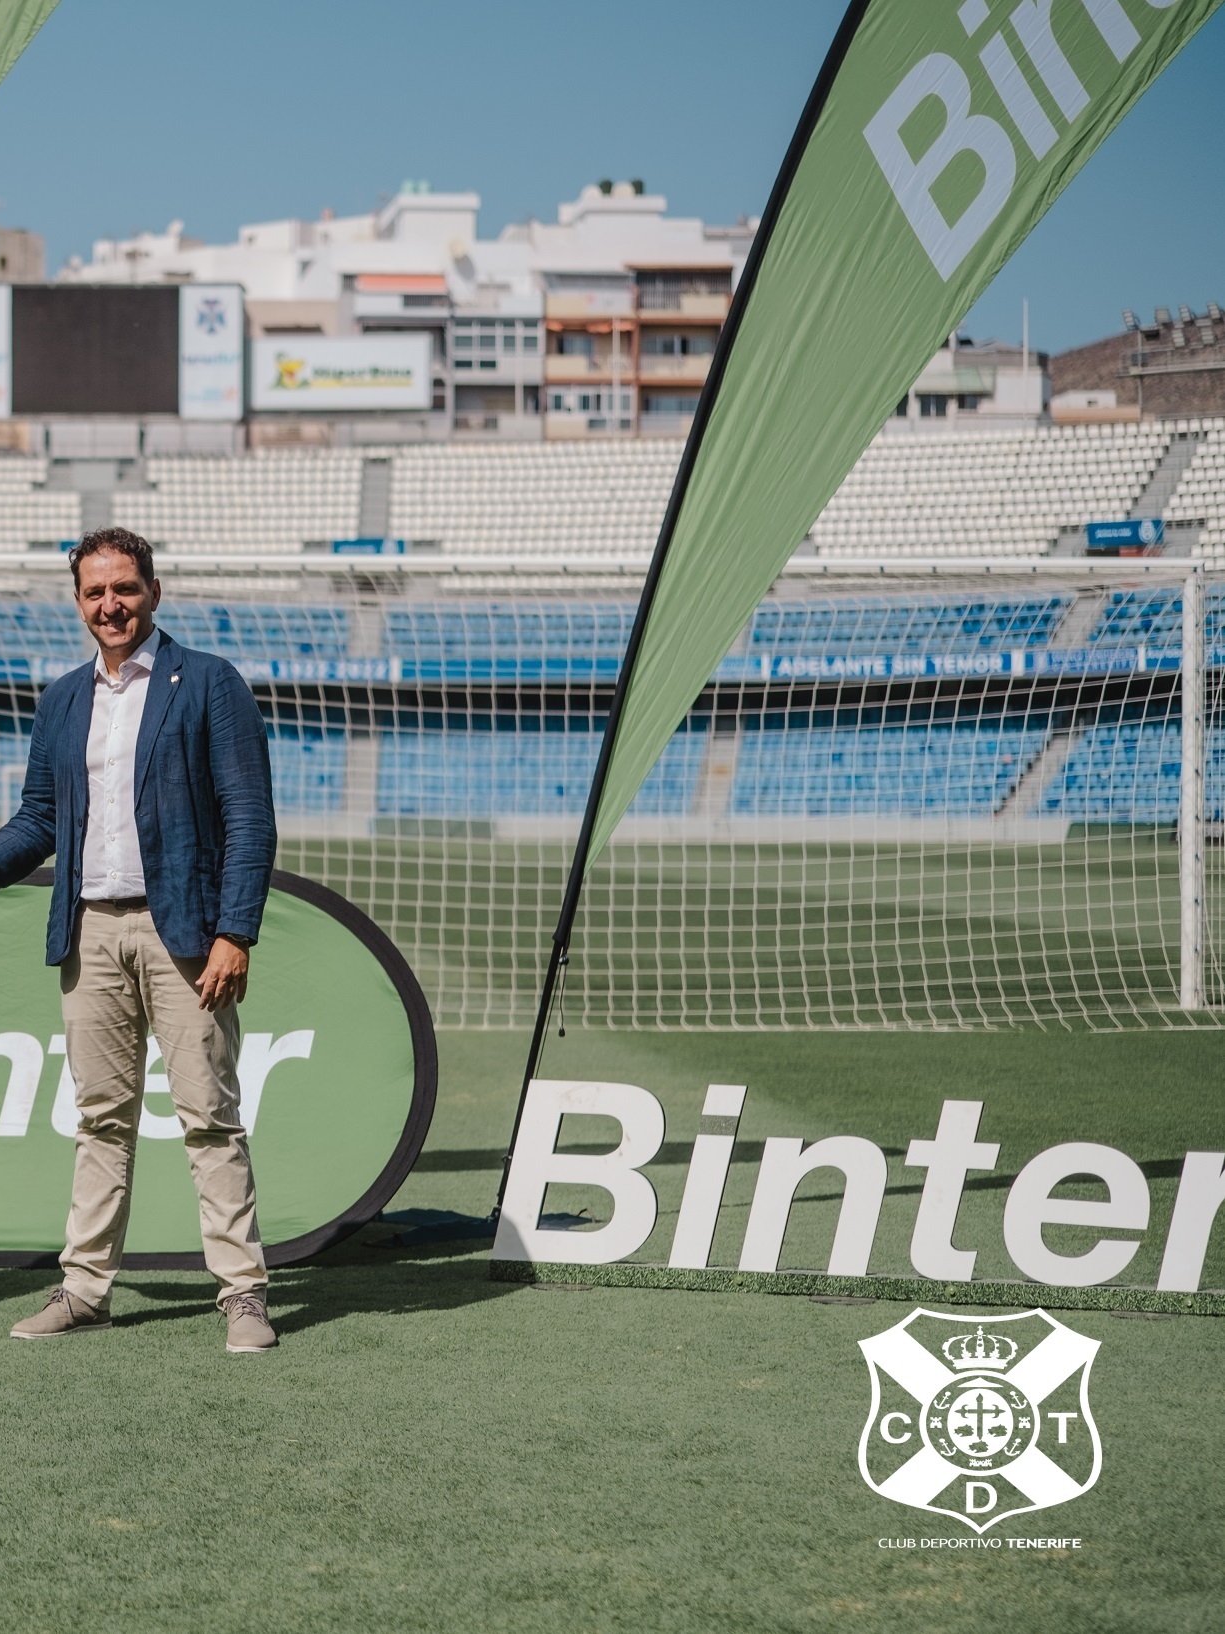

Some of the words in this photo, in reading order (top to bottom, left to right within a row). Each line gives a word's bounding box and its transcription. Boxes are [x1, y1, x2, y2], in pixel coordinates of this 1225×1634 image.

[862, 0, 1176, 283] Bin
[778, 656, 887, 676] ADELANTE
[892, 654, 926, 674] SIN
[934, 653, 1004, 674] TEMOR
